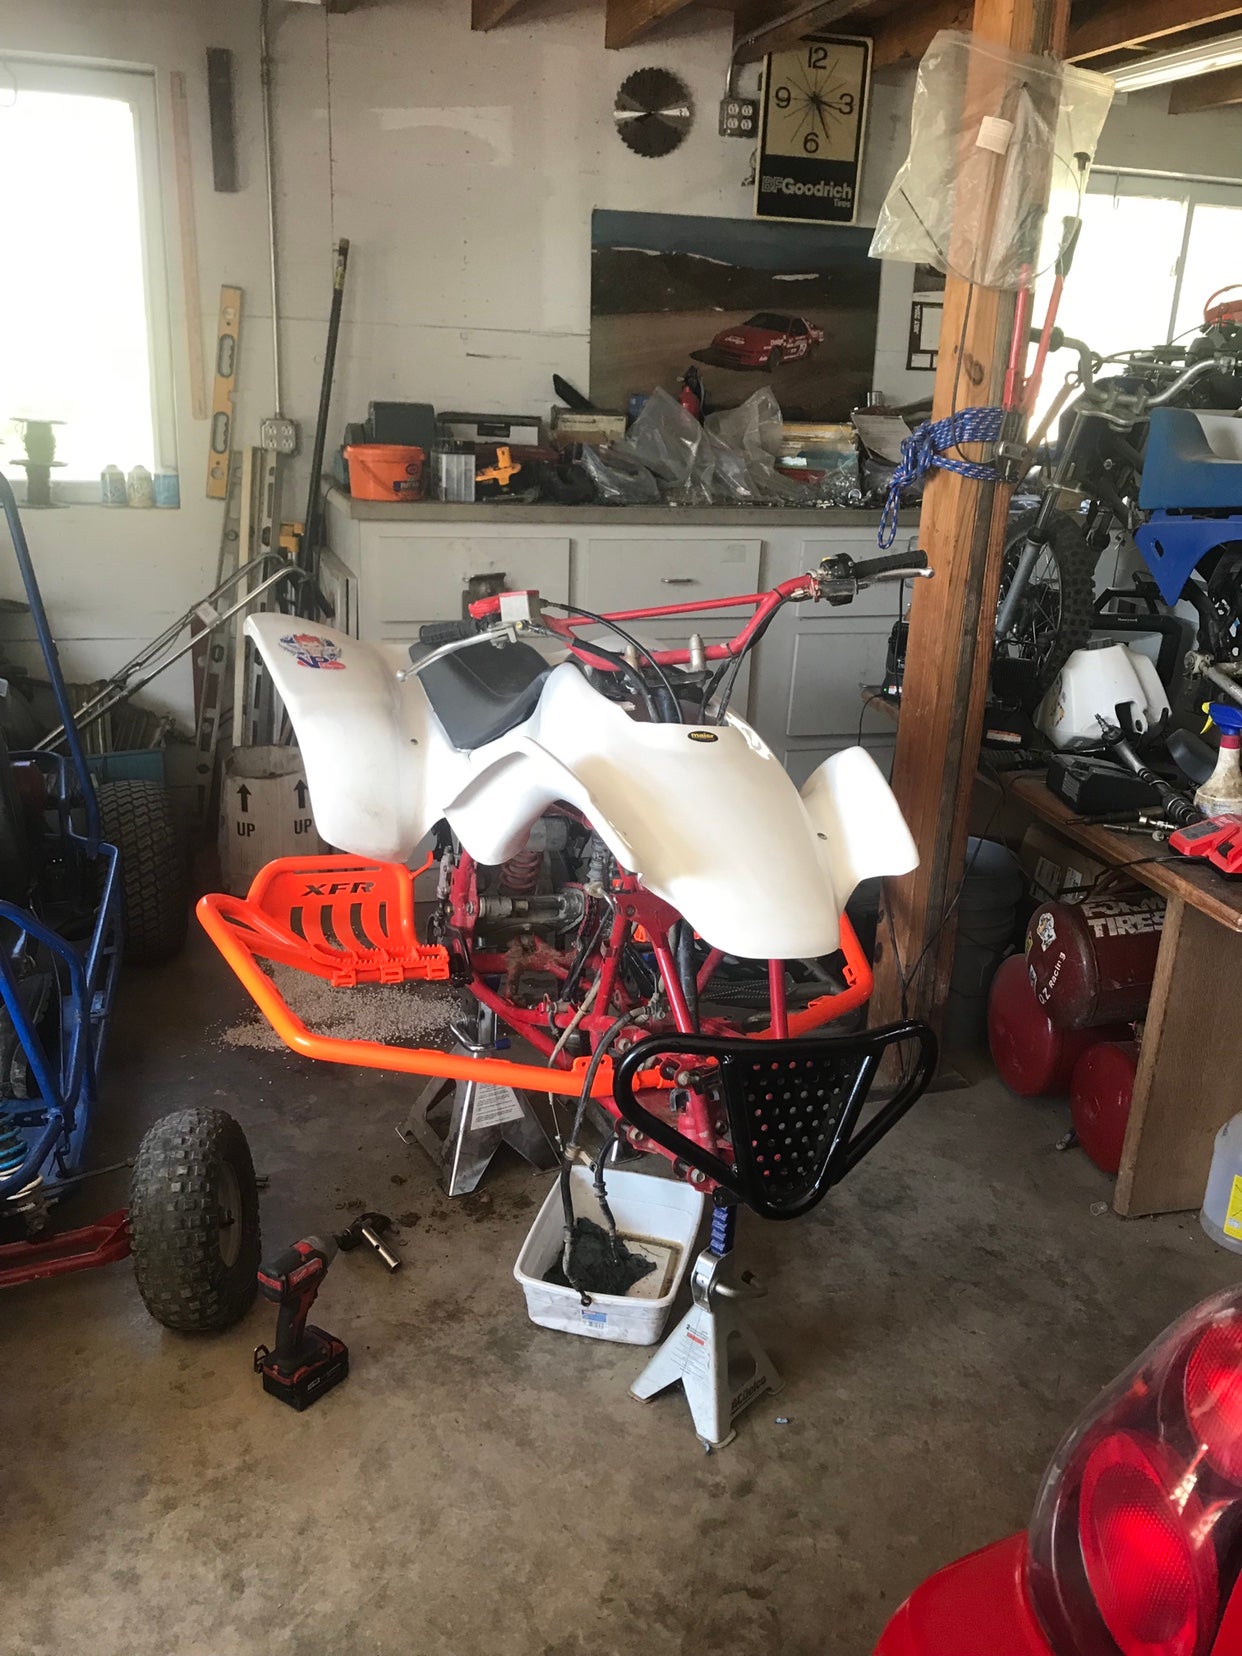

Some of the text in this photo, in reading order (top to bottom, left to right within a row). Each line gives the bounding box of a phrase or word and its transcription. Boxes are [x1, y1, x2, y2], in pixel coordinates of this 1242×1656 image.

[807, 46, 828, 70] 12
[775, 86, 791, 108] 9
[838, 93, 854, 115] 3
[803, 132, 819, 154] 6
[761, 175, 852, 199] BFGoodrich
[236, 818, 312, 837] UP UP
[301, 881, 375, 897] XFR
[1048, 951, 1067, 989] Racing
